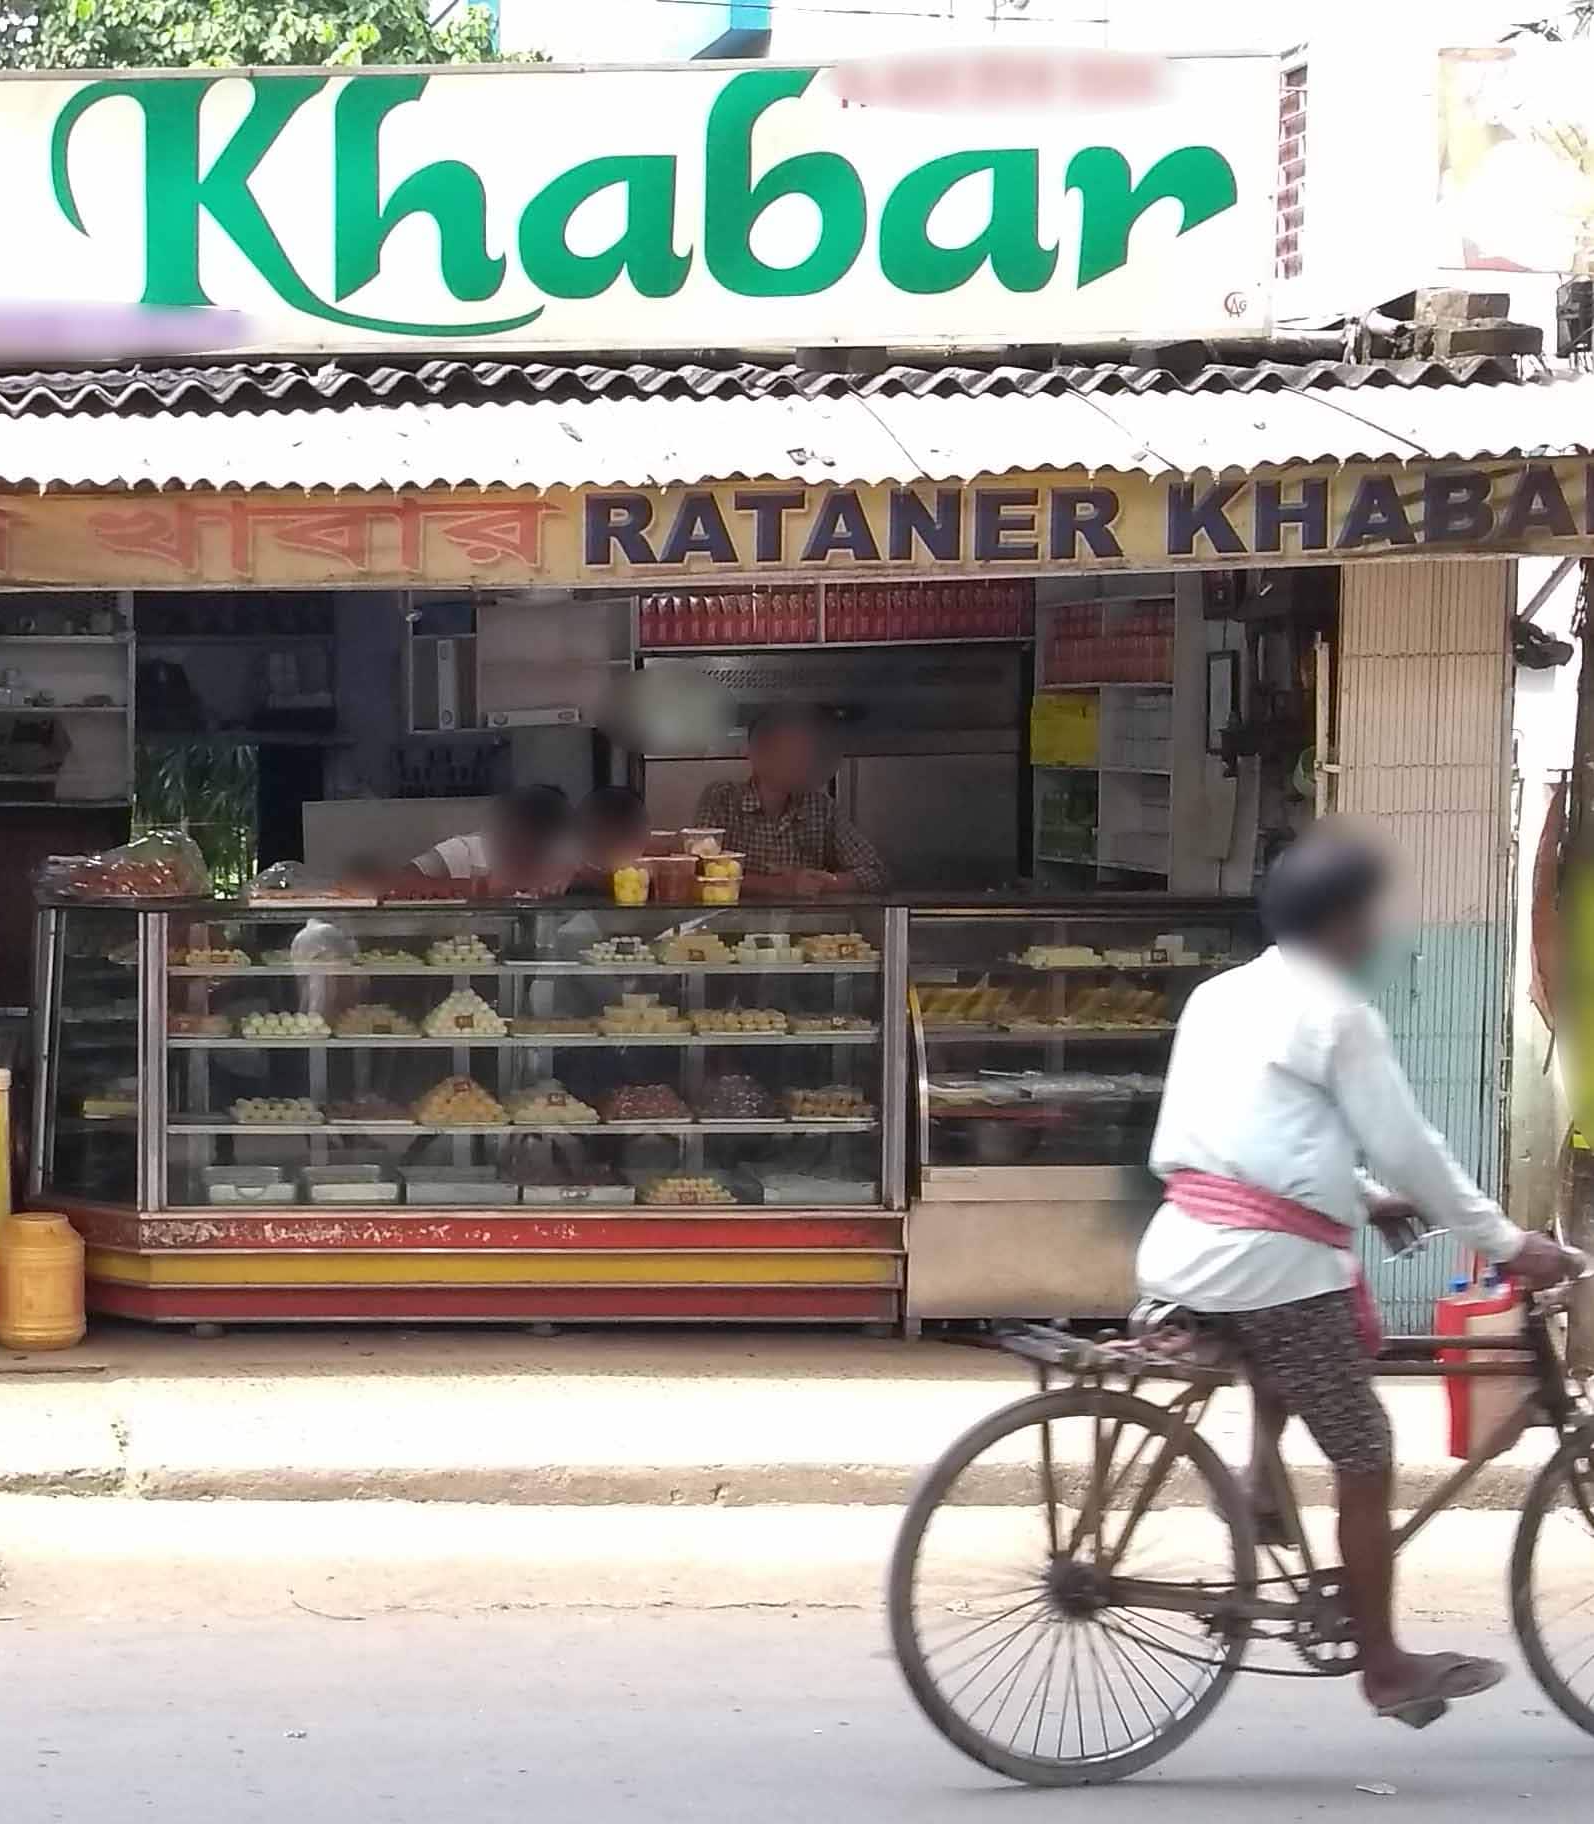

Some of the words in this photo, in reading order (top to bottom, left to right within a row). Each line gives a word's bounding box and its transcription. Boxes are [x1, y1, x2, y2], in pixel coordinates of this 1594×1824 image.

[51, 70, 1238, 337] Khabar
[89, 500, 566, 577] খাবার
[584, 486, 1124, 566] RATANER
[1166, 464, 1594, 556] KHABA
